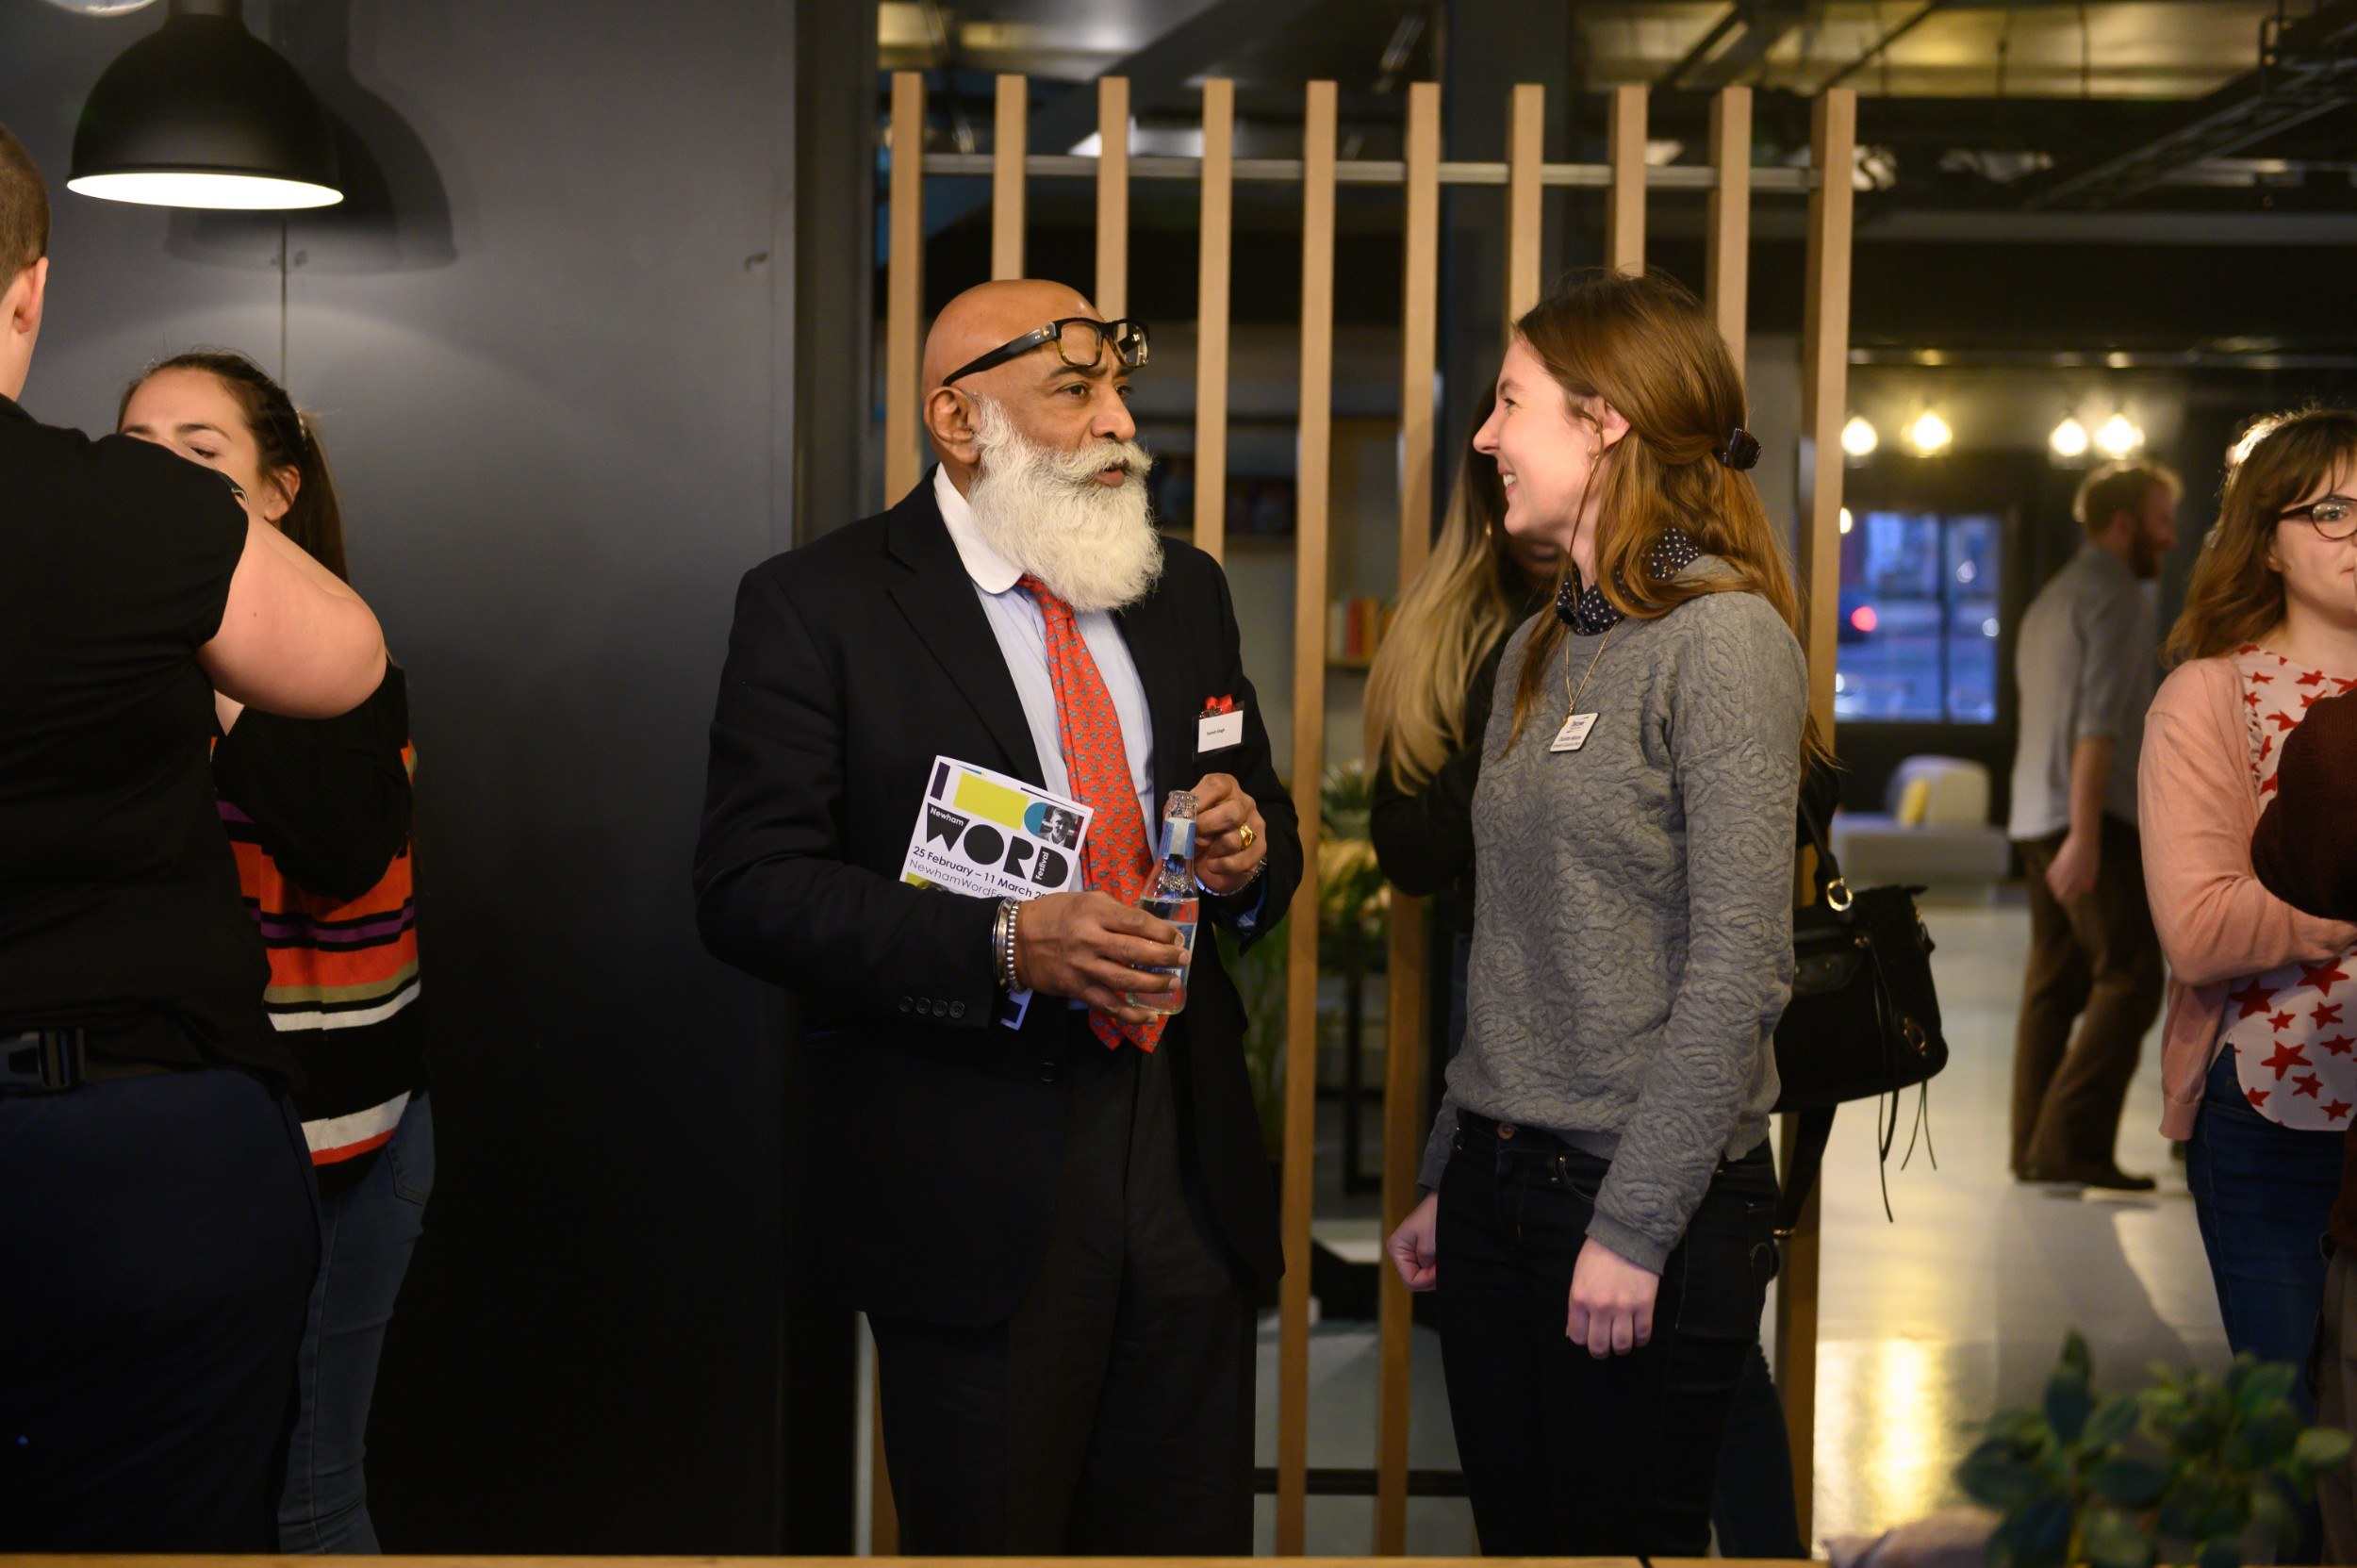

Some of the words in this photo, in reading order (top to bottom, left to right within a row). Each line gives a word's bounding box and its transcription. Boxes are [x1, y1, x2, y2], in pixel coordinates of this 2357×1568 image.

[930, 807, 964, 827] Newham
[927, 802, 1069, 888] WORD
[1035, 850, 1049, 881] Festival
[913, 846, 926, 858] 25
[927, 851, 974, 877] February
[984, 872, 996, 883] 11
[997, 878, 1032, 898] March
